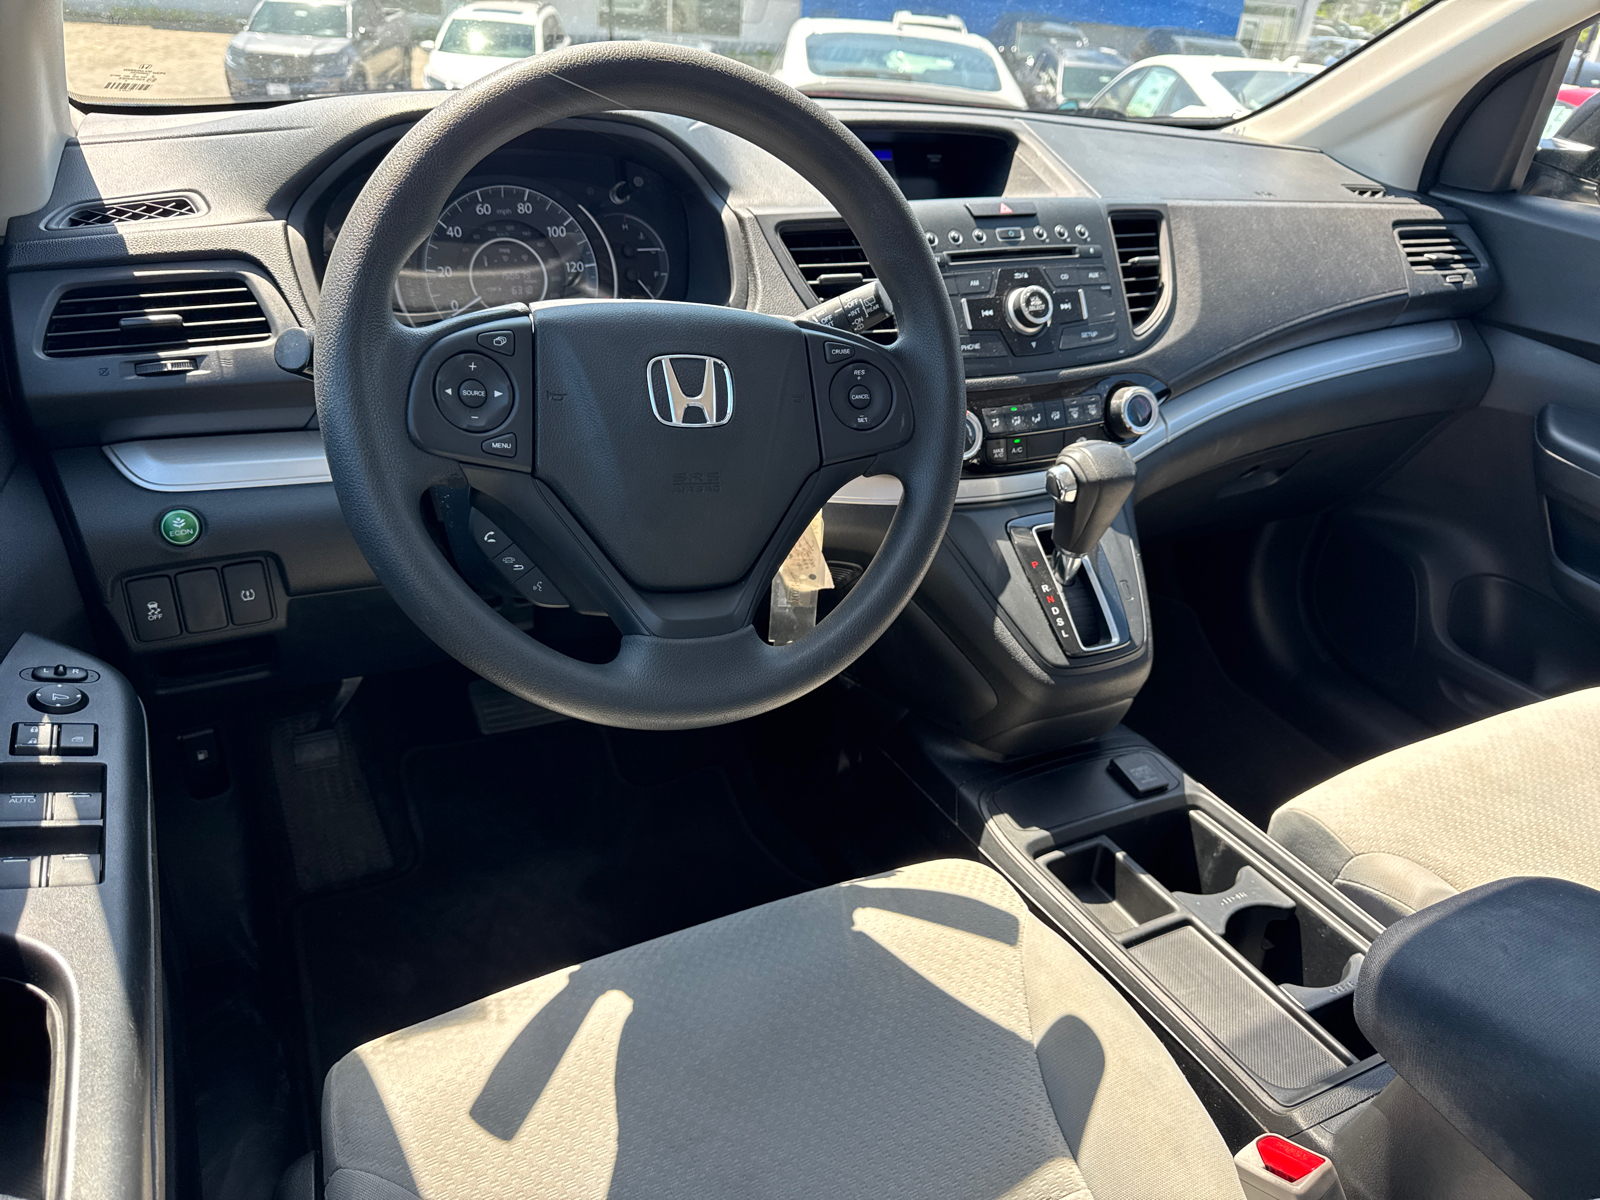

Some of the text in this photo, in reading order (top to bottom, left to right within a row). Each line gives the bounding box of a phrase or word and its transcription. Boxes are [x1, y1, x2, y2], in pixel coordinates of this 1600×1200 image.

[476, 203, 532, 216] 60 mph 80
[446, 226, 462, 238] 40
[547, 226, 566, 238] 100
[437, 266, 452, 278] 20
[565, 262, 584, 273] 120
[847, 298, 859, 308] OFF
[866, 304, 880, 313] REAR
[820, 314, 833, 324] OFF
[1081, 330, 1098, 339] SETUP
[961, 342, 981, 351] PHONE
[462, 389, 485, 397] SOURCE
[1011, 446, 1023, 454] A/C
[672, 472, 720, 482] SRS
[169, 528, 194, 537] ECON
[1031, 561, 1038, 569] P
[1041, 584, 1050, 593] R
[1046, 595, 1055, 603] N
[1051, 606, 1060, 615] D
[147, 612, 163, 621] OFF
[1056, 617, 1065, 627] S
[1061, 629, 1069, 638] L
[8, 796, 37, 804] AUTO
